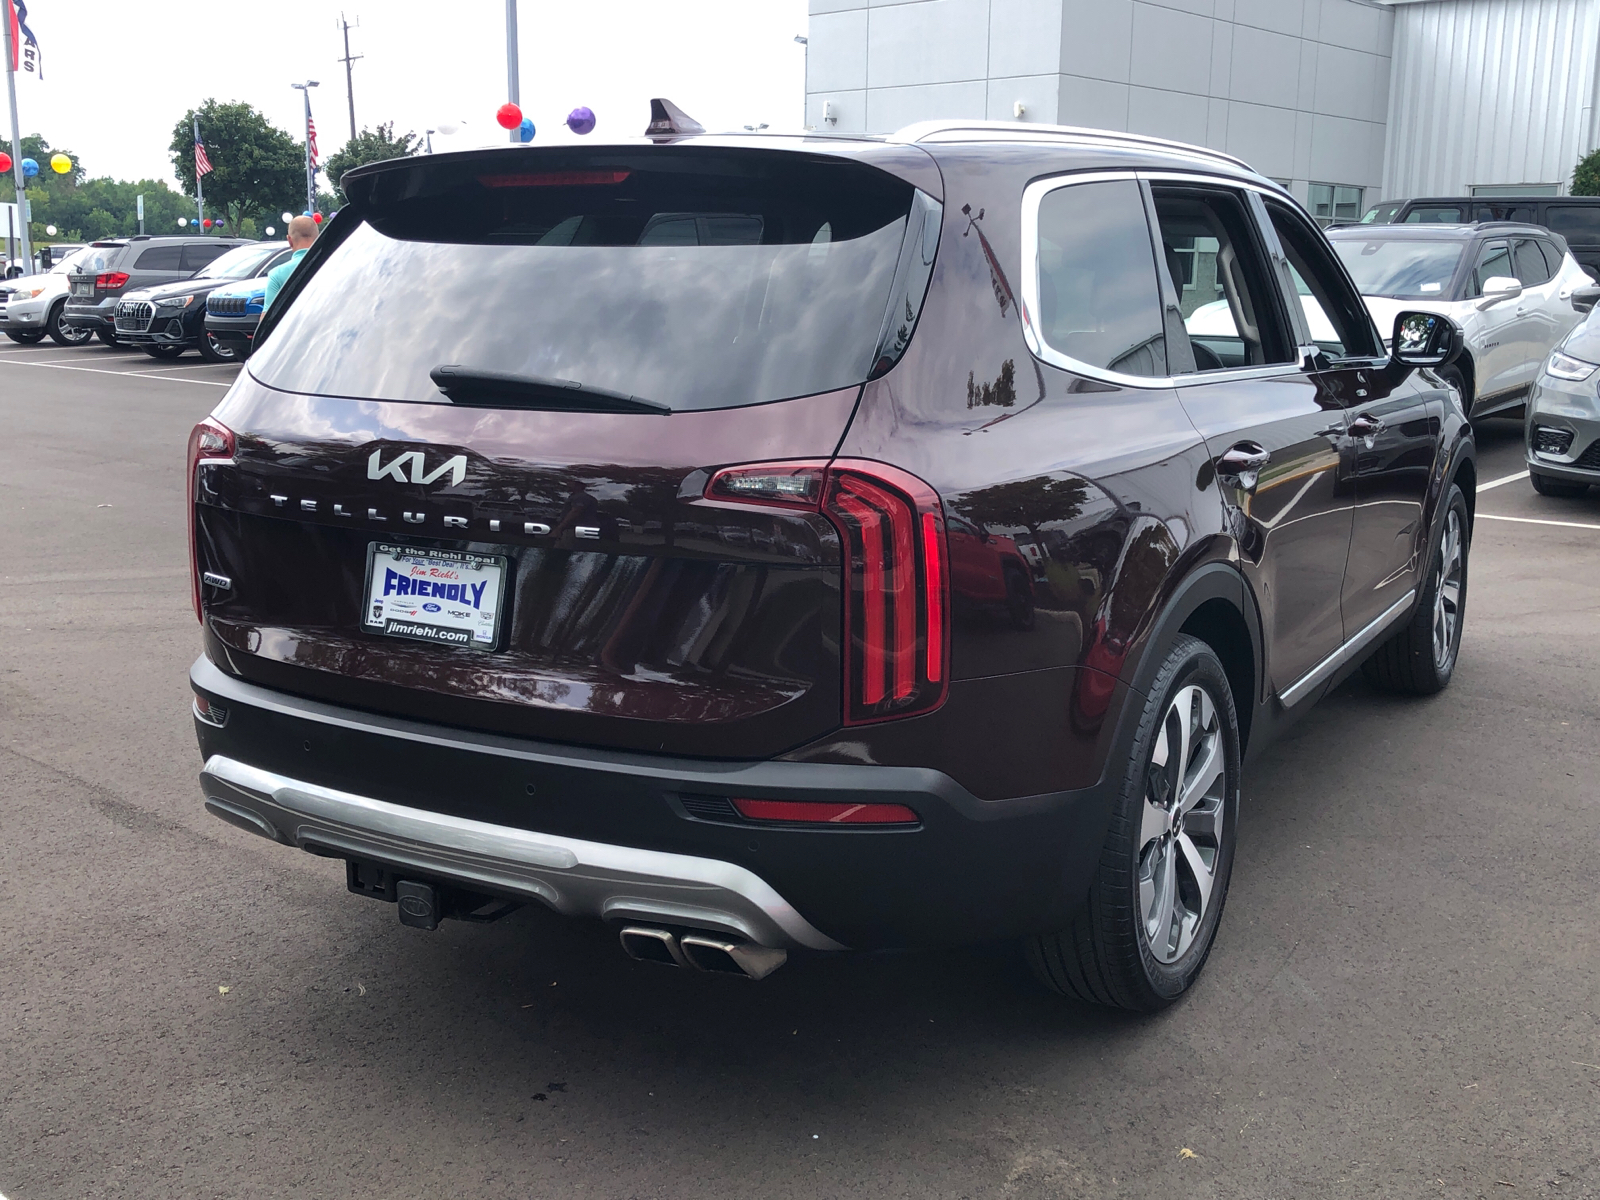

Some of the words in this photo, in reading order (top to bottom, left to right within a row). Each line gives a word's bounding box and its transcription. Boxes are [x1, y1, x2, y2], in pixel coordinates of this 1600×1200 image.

[367, 448, 468, 488] KIA
[269, 493, 601, 540] TELLURIDE
[379, 544, 402, 553] Get
[429, 550, 462, 560] Riehl
[465, 554, 495, 564] Deal
[411, 557, 425, 566] Your
[205, 574, 228, 587] AWD
[409, 565, 427, 577] Jim
[429, 567, 460, 580] Riehl's
[383, 566, 488, 610] FRIENDLY
[423, 602, 441, 613] Ford
[447, 610, 471, 618] MOKE
[386, 621, 469, 643] jimriehl.com
